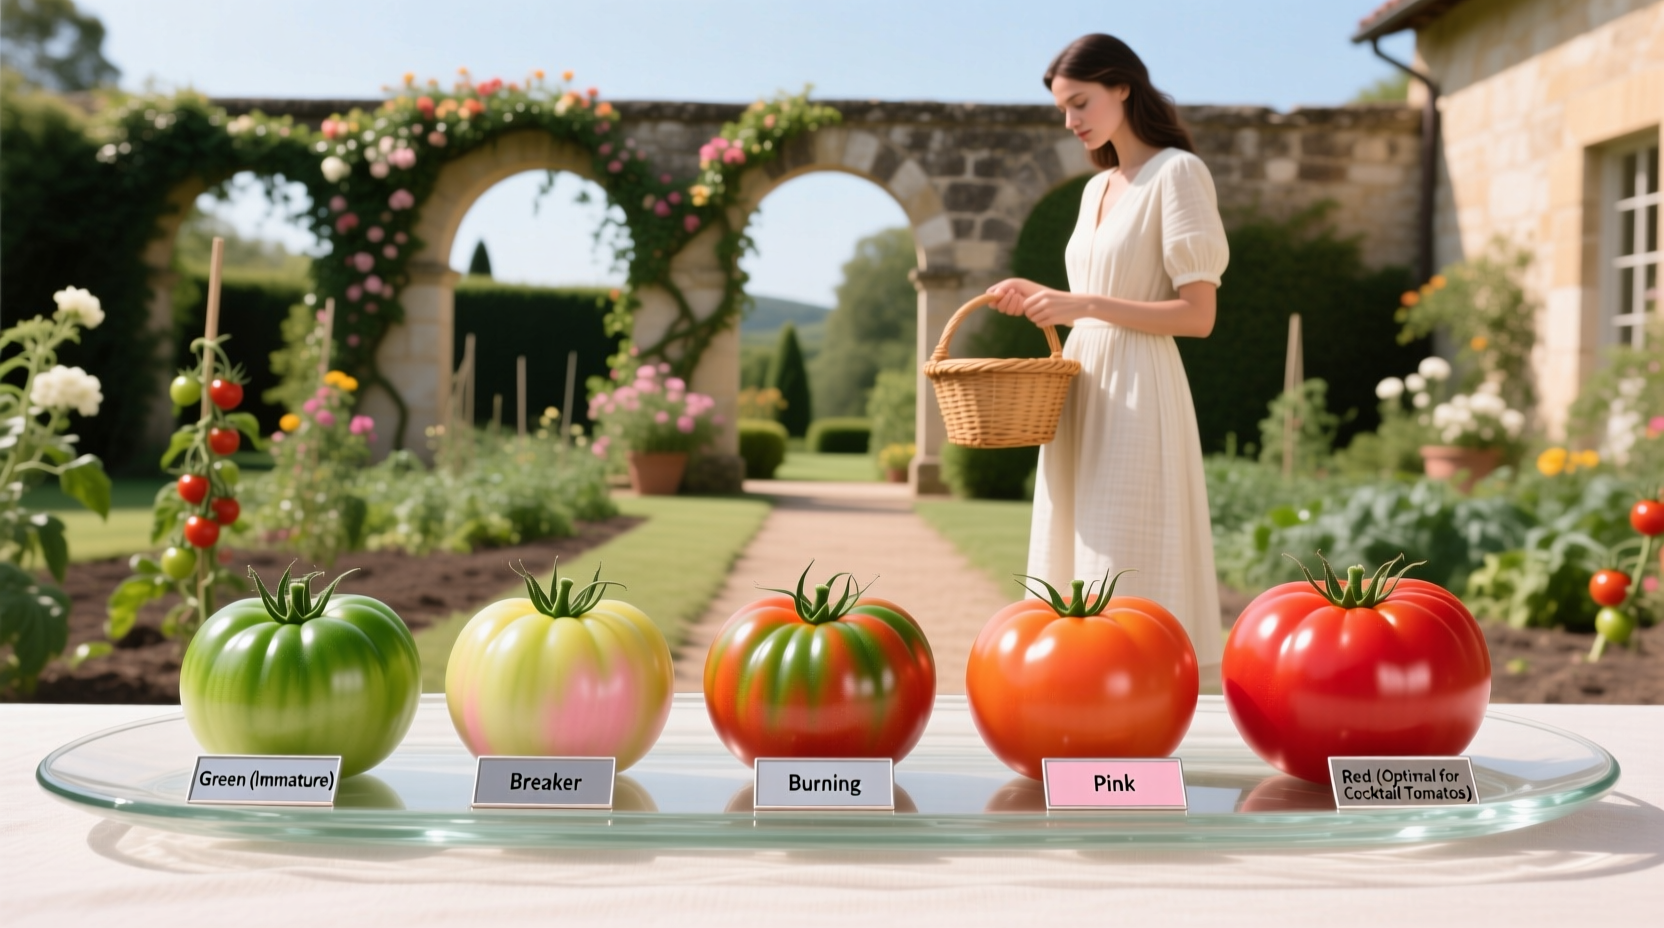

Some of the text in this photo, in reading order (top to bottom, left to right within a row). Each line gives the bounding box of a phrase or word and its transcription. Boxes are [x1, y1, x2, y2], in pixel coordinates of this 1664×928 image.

[200, 769, 334, 791] Green (Immature)
[510, 772, 582, 791] Breaker
[789, 774, 861, 796] Burning
[1094, 773, 1136, 792] Pink
[1342, 768, 1372, 784] Red
[1439, 768, 1460, 783] for
[1344, 785, 1472, 802] Cocktail Tomatos)
